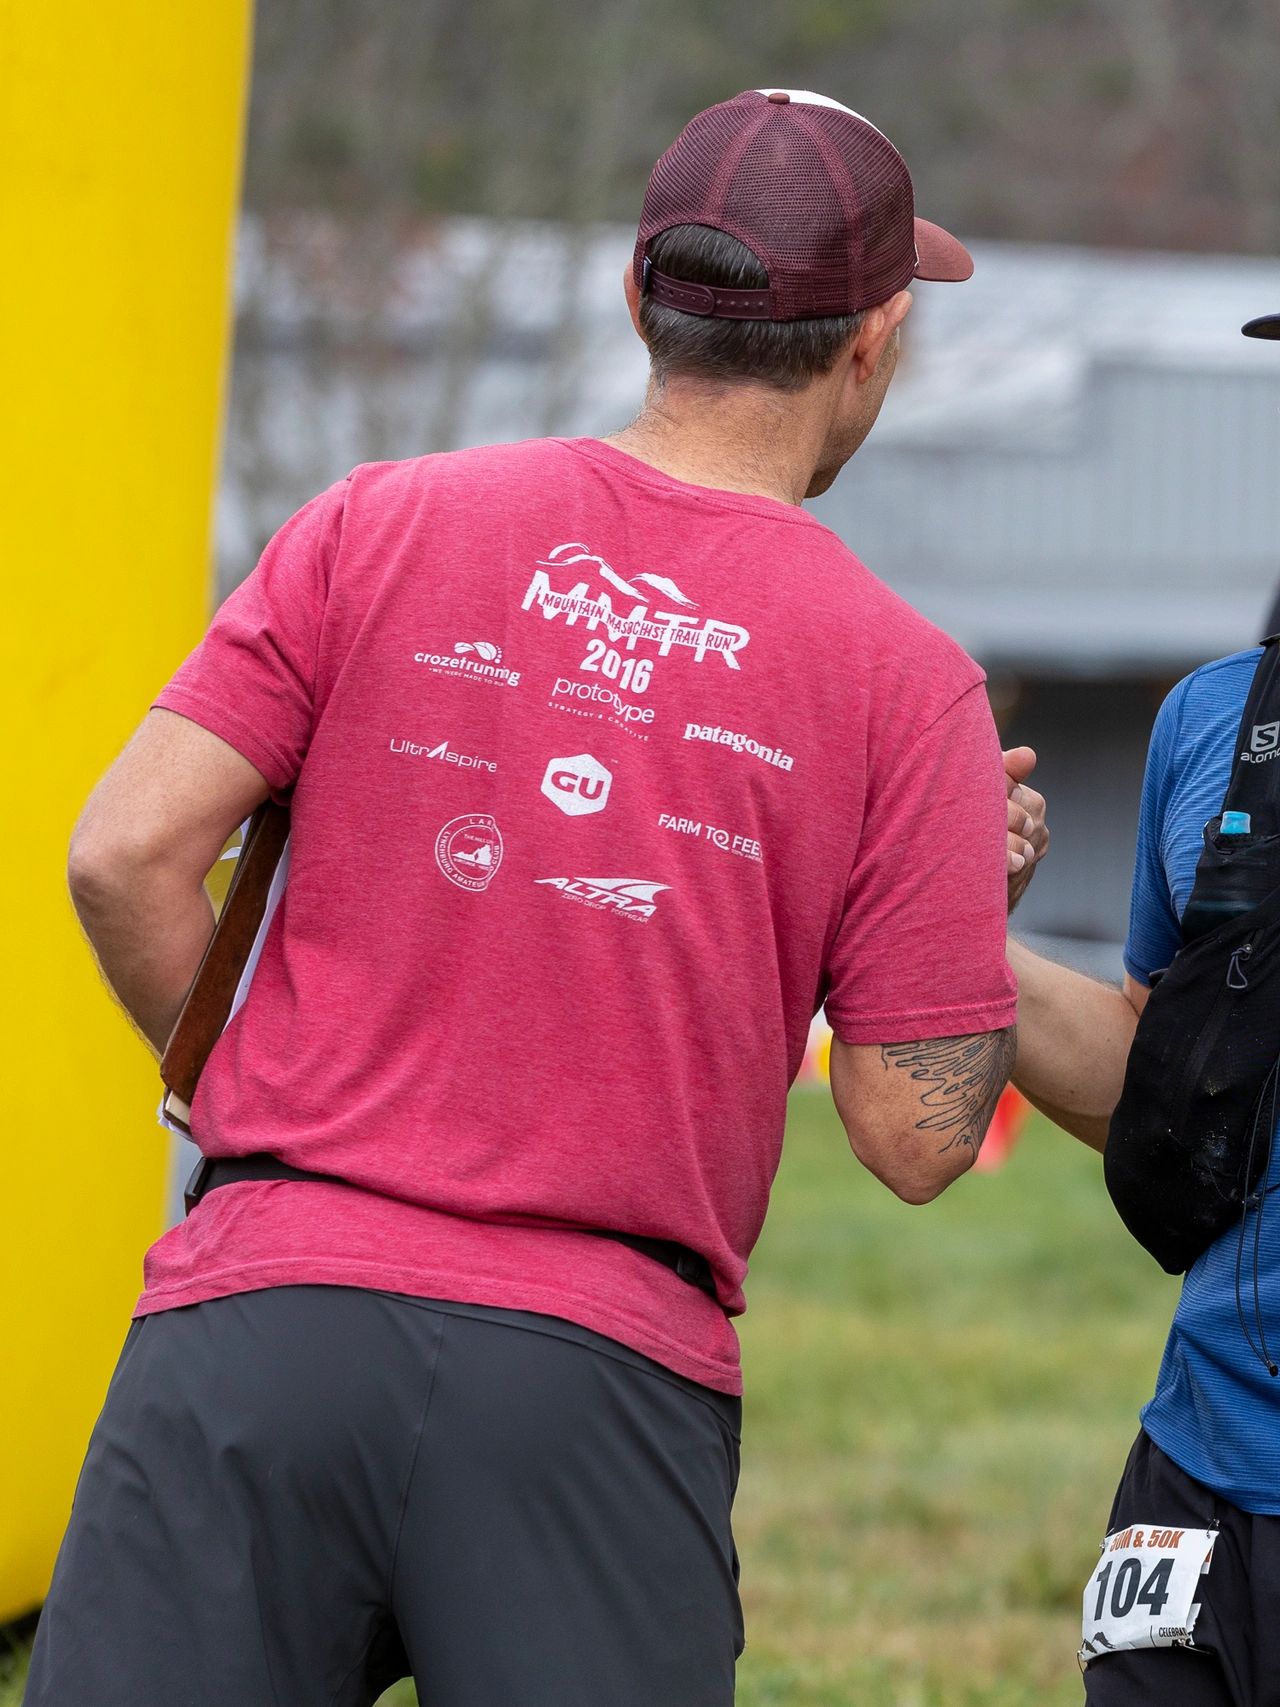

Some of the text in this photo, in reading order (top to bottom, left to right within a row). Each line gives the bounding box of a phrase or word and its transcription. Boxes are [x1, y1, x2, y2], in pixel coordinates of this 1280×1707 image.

[521, 570, 750, 670] MMTR
[542, 593, 732, 650] MOUNTAIN MASOCHIST TRAIL RUN
[580, 638, 654, 694] 2016
[552, 677, 655, 723] prototype
[389, 738, 498, 772] UltrAspire
[682, 722, 795, 772] patagonia
[551, 770, 605, 800] GU
[657, 813, 701, 837] FARM
[732, 835, 762, 857] FEE
[533, 877, 657, 917] ALTRA
[561, 893, 584, 904] ZERO
[583, 899, 607, 910] DROP
[1133, 1530, 1144, 1548] &
[1147, 1529, 1186, 1549] 50K
[1094, 1557, 1176, 1621] 104
[1158, 1627, 1188, 1638] CELEBRAT
